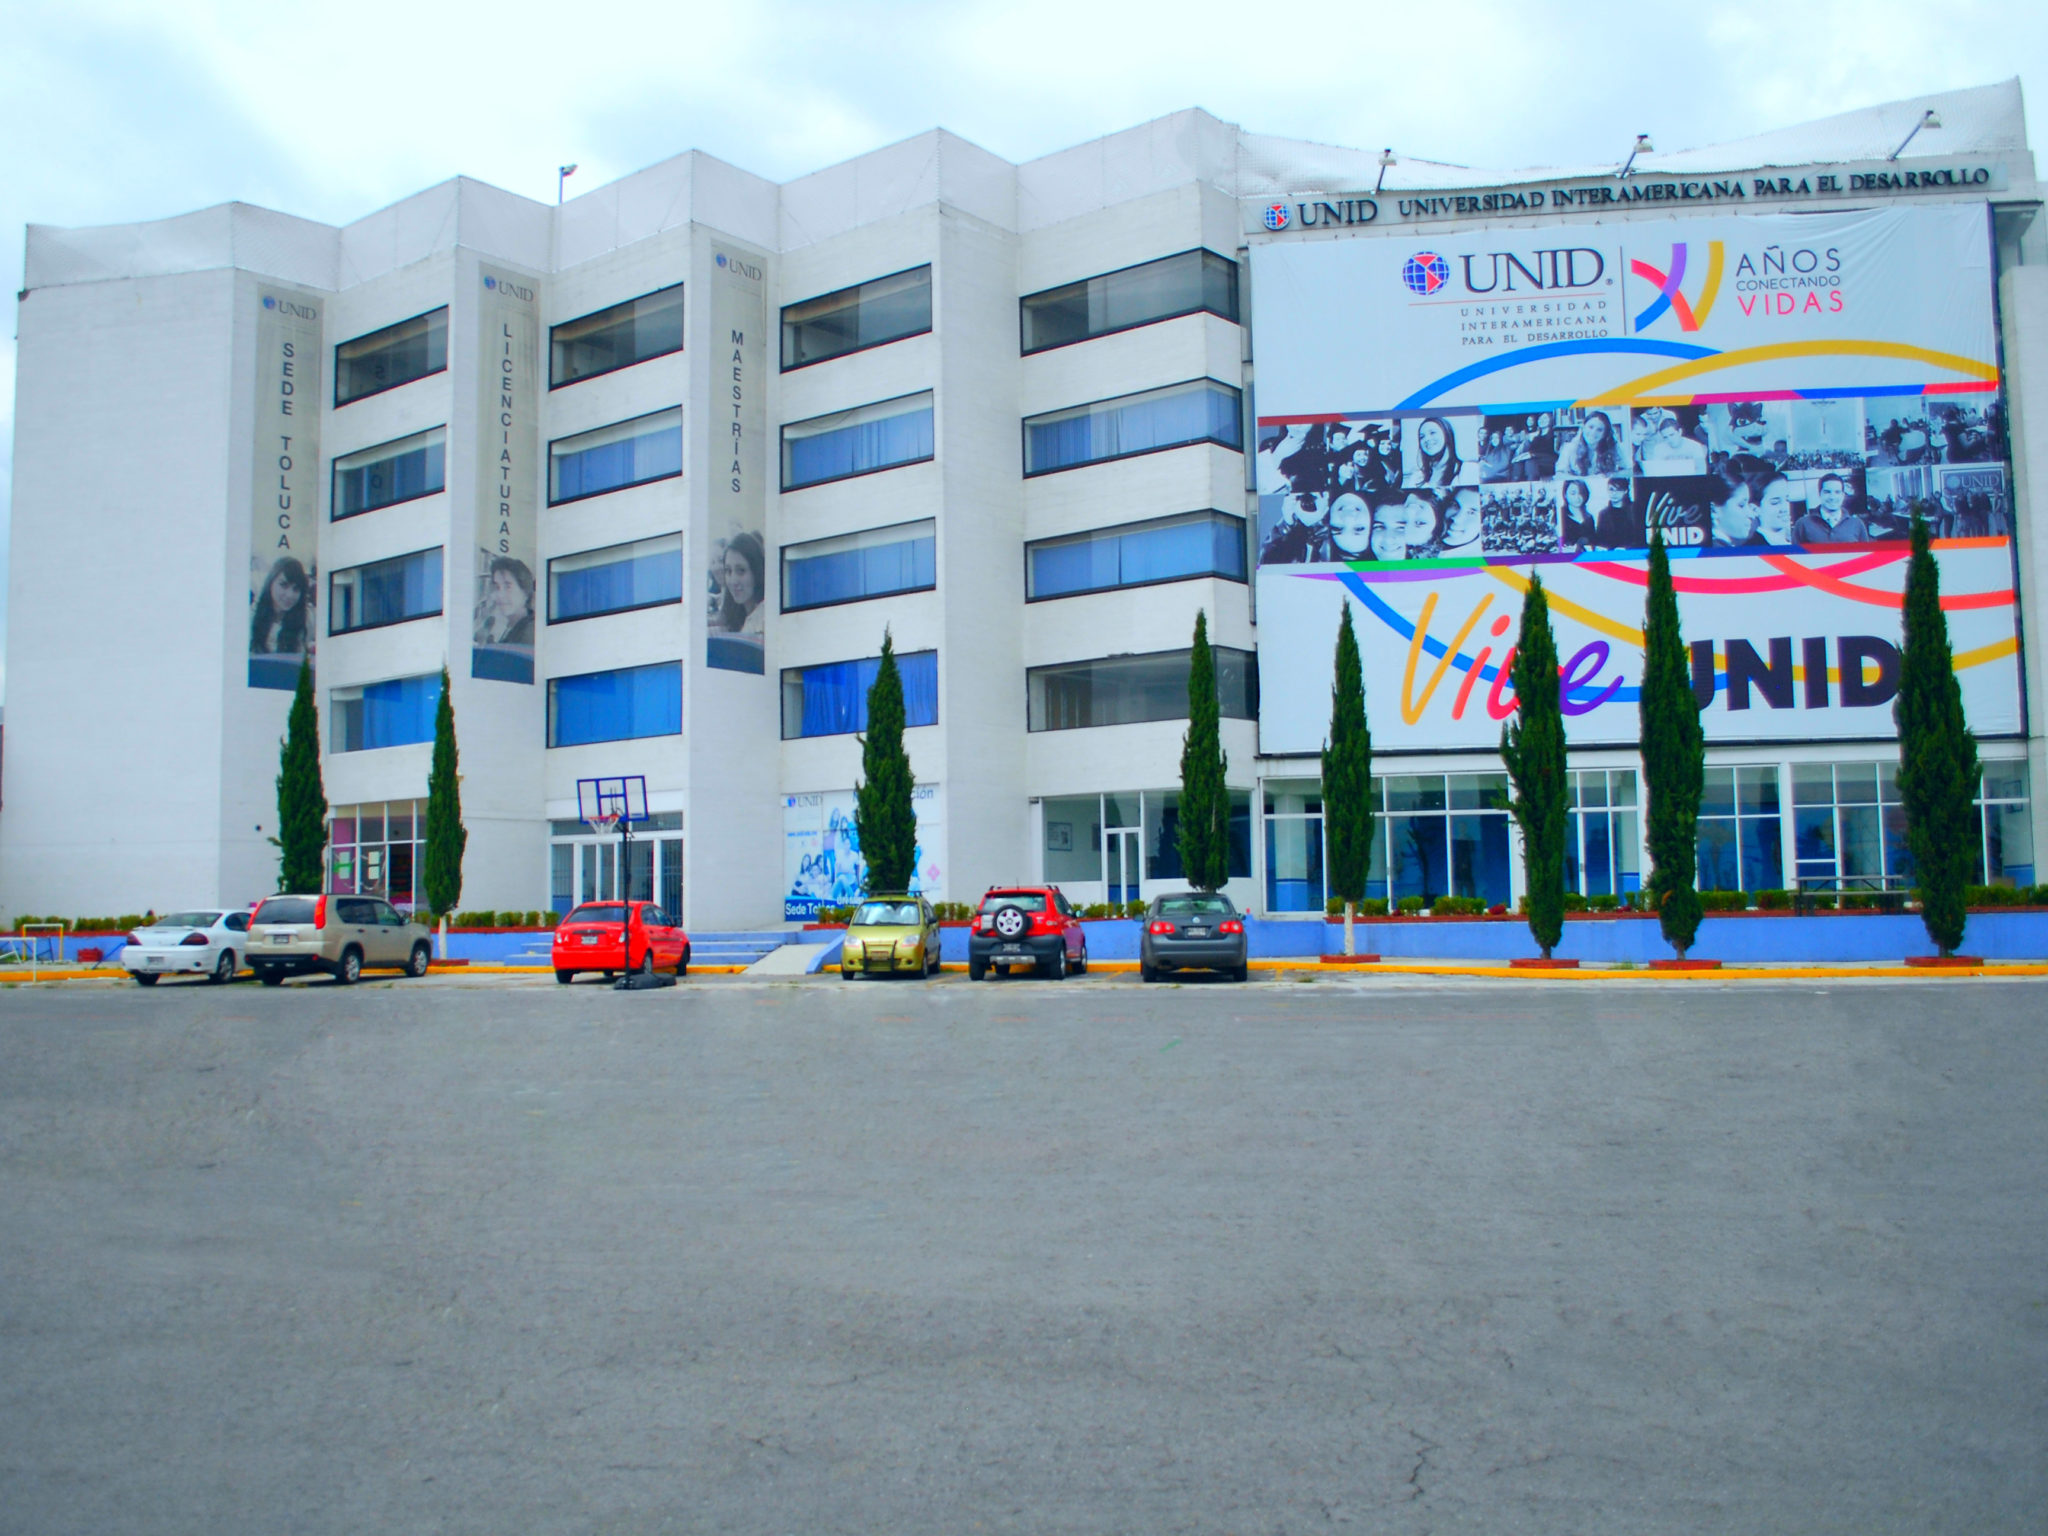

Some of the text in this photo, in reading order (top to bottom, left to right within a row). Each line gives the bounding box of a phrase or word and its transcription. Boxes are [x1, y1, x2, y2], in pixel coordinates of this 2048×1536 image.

[1297, 168, 1990, 226] UNID UNIVERSIDAD INTERAMERICANA PARA EL DESARROLLO
[729, 258, 762, 281] UNID
[1458, 248, 1605, 293] UNID
[1736, 245, 1841, 277] AÑOS
[499, 281, 534, 302] UNID
[1736, 275, 1841, 291] CONECTANDO
[278, 301, 317, 321] UNID
[1460, 301, 1606, 317] UNIVERSIDAD
[1738, 290, 1843, 317] VIDAS
[1461, 316, 1607, 331] INTERAMERICANA
[1462, 329, 1608, 345] PARA EL DESARROLLO
[278, 342, 295, 549] SEDE TOLUCA
[500, 323, 513, 553] LICENCIATURAS
[1962, 475, 1999, 489] UNID
[1645, 491, 1703, 527] Vive
[785, 903, 807, 915] Sede
